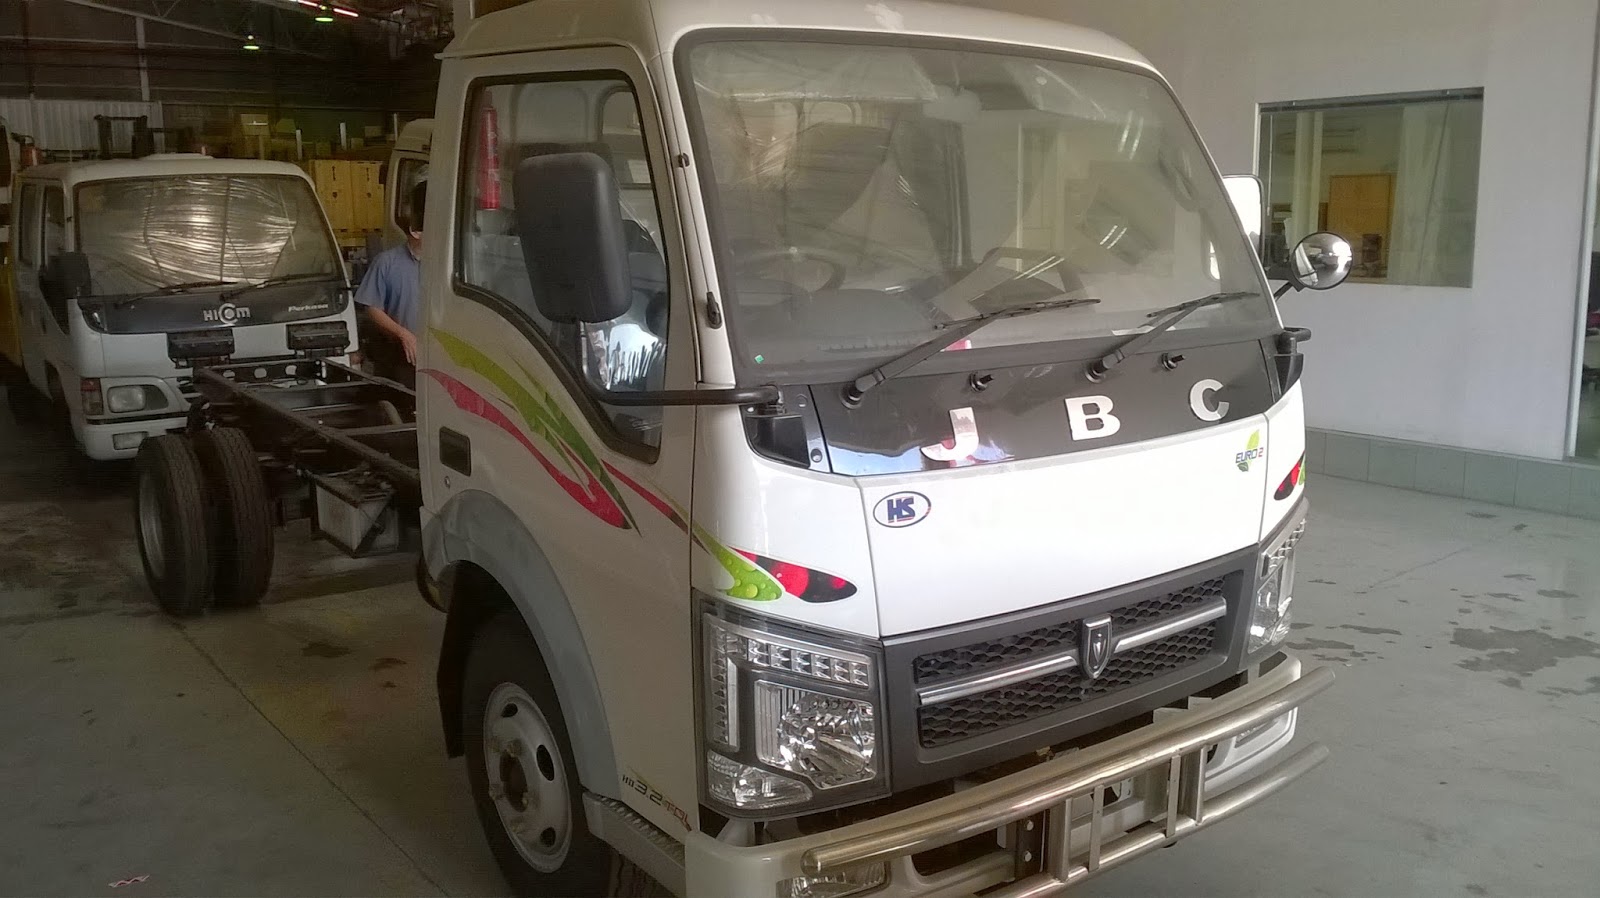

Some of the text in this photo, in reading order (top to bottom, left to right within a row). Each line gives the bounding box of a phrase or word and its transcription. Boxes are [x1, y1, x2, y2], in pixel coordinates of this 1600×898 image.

[1235, 447, 1264, 464] EURO 2
[887, 496, 916, 523] HS
